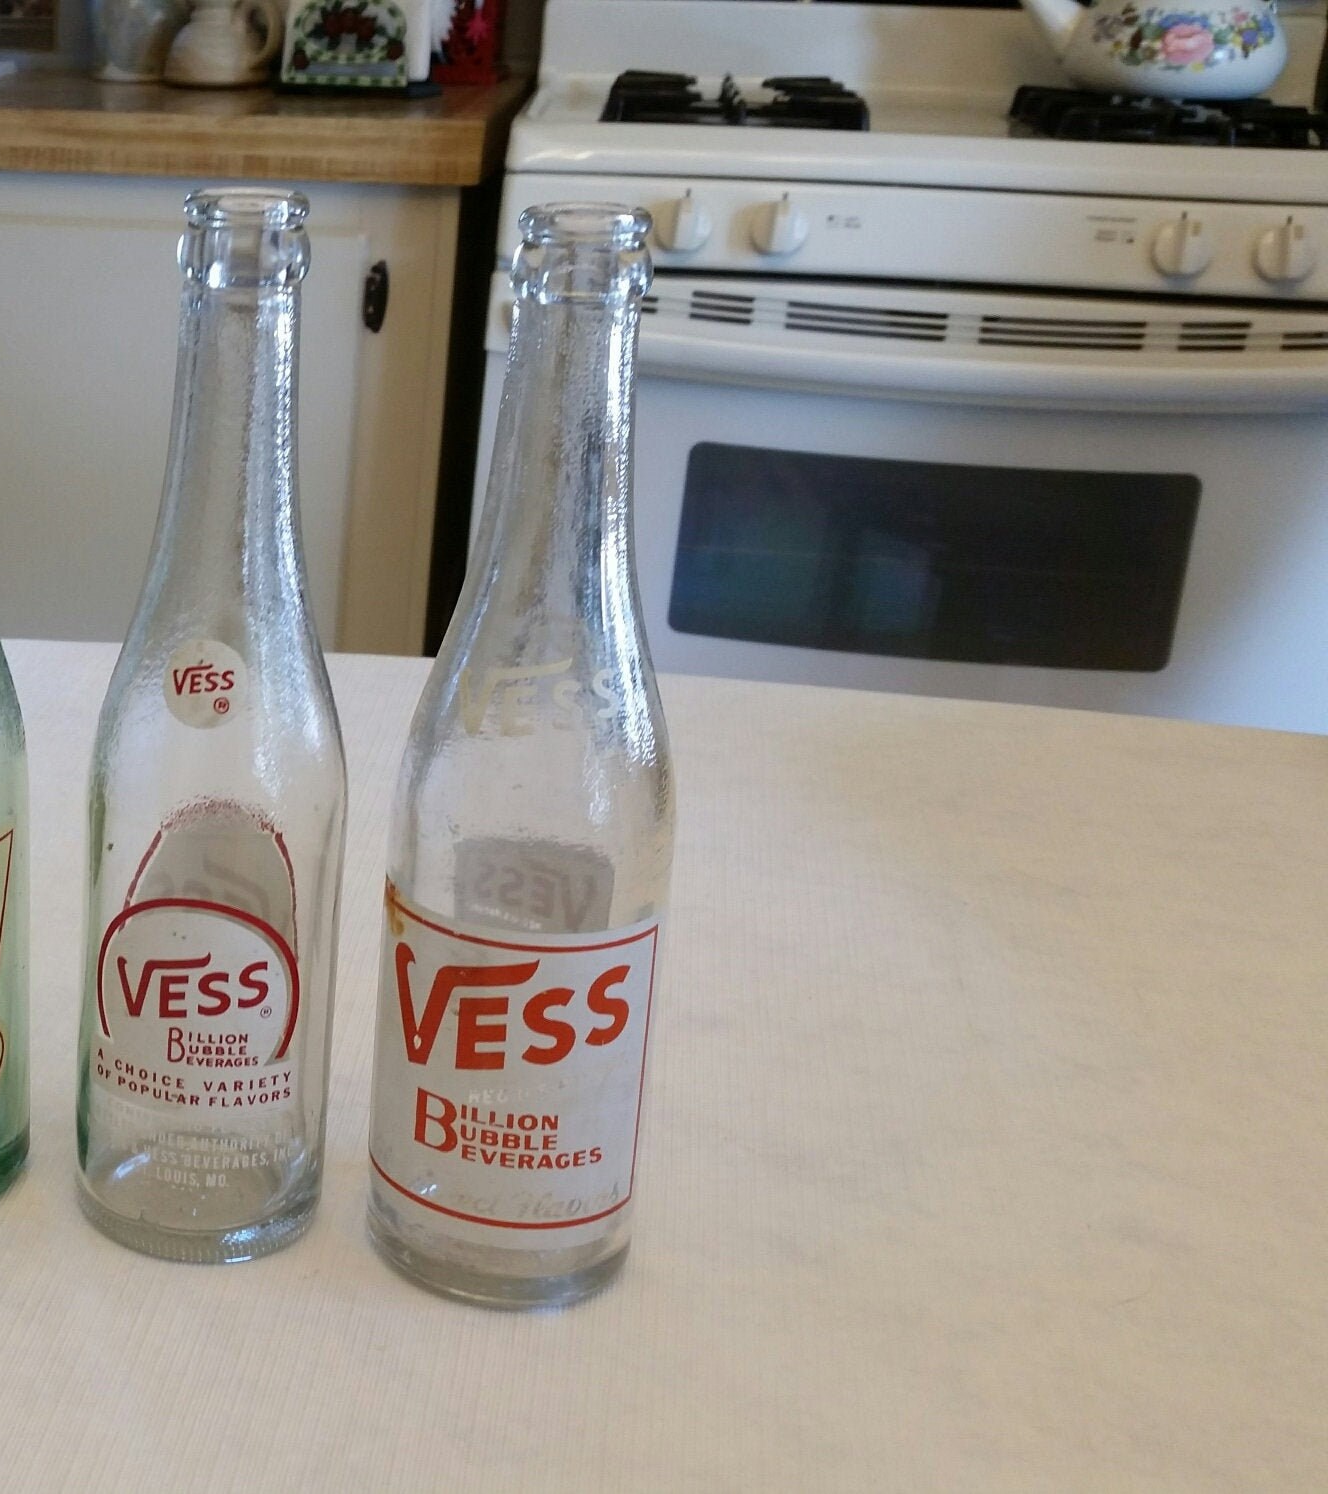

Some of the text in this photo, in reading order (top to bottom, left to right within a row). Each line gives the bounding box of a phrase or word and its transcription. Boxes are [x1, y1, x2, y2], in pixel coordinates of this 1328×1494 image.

[173, 662, 235, 695] VESS
[459, 657, 624, 738] VESS
[117, 952, 269, 1019] VESS
[395, 942, 632, 1071] VESS
[97, 1048, 291, 1092] A CHOICE VARIETY
[97, 1063, 291, 1107] OF POPULAR FLAVORS
